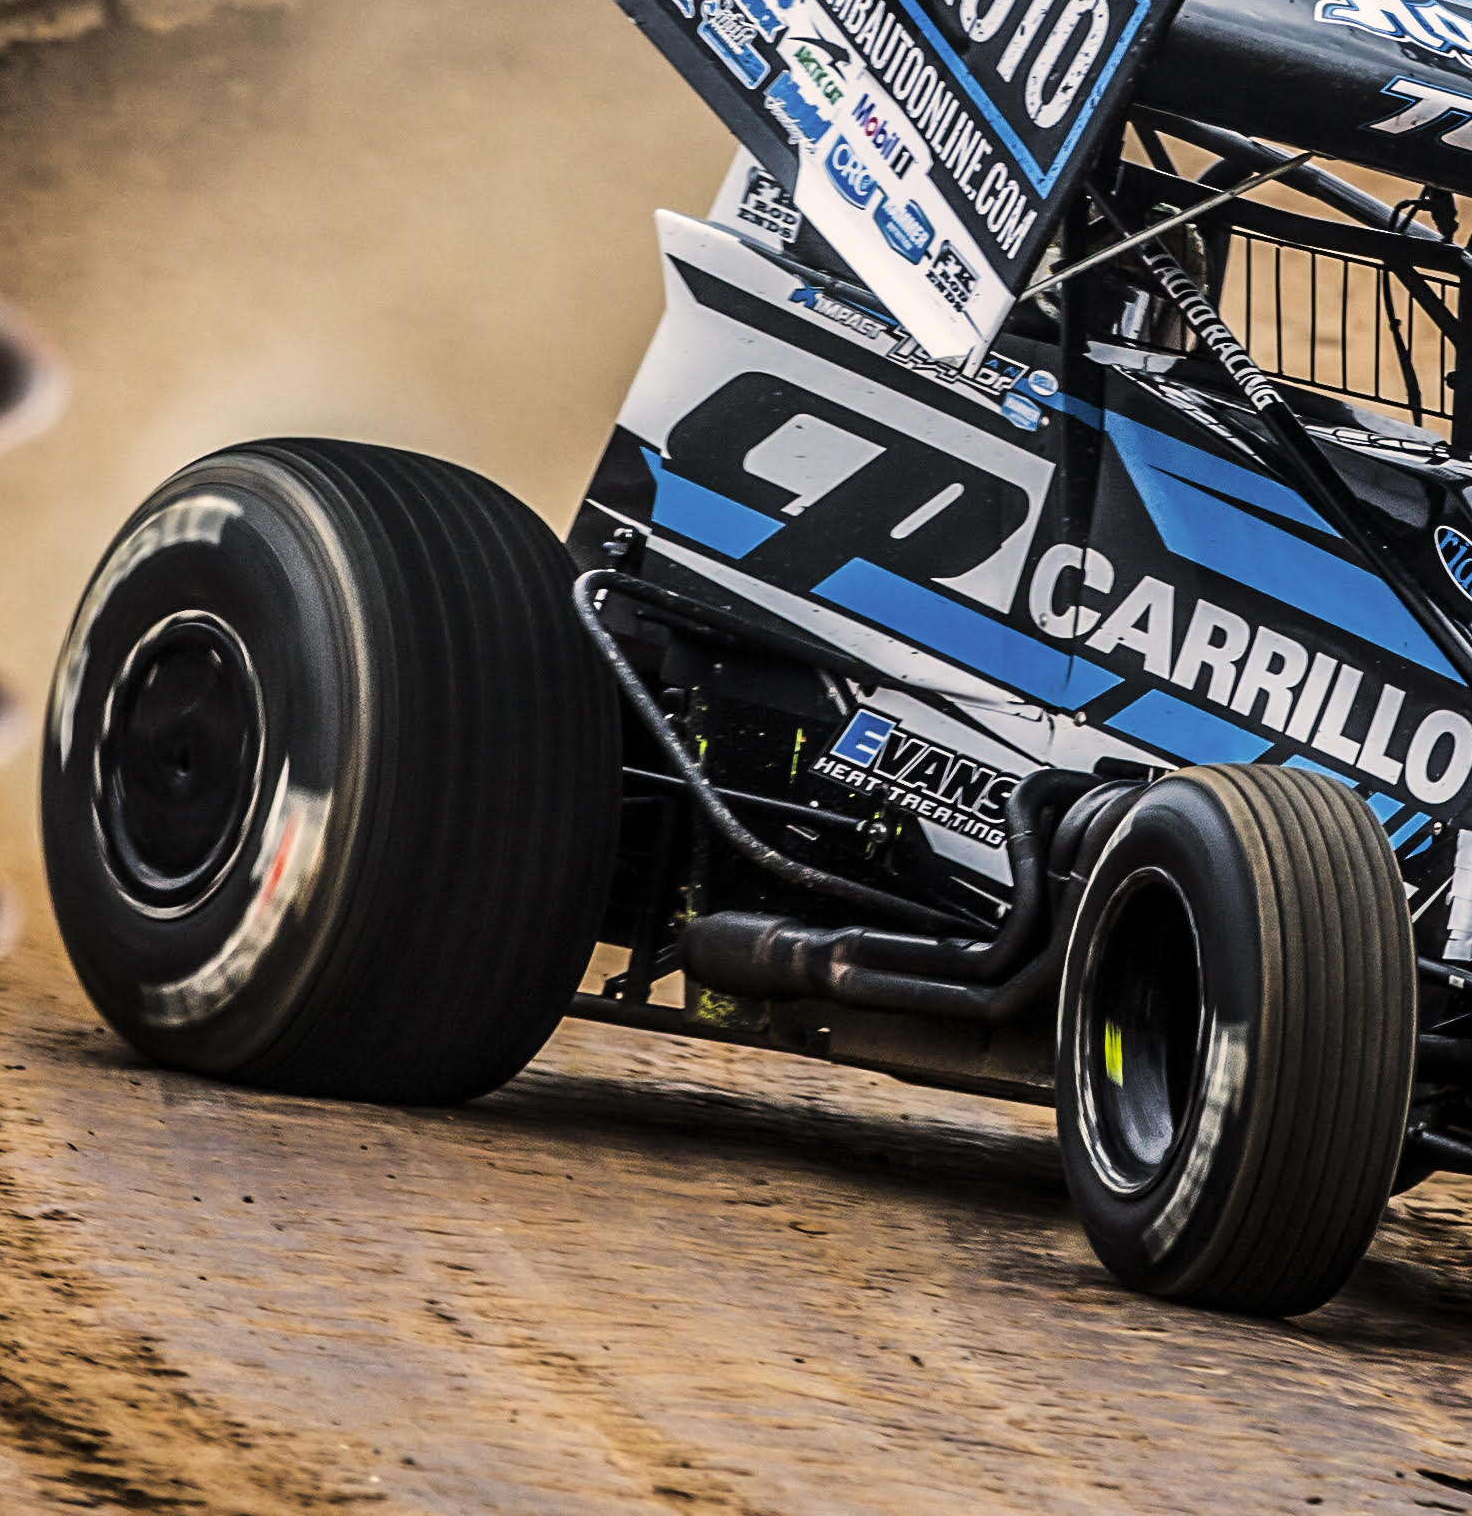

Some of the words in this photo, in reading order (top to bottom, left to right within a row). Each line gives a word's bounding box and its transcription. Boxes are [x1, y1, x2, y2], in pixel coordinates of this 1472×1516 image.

[851, 93, 902, 161] Mobil
[831, 144, 877, 196] CRC
[737, 207, 793, 239] ENDS
[1153, 267, 1219, 327] AUTO
[1200, 320, 1284, 412] RACING
[813, 757, 882, 791] HEAT
[887, 786, 1006, 845] TREATING
[829, 708, 1021, 824] EVANS
